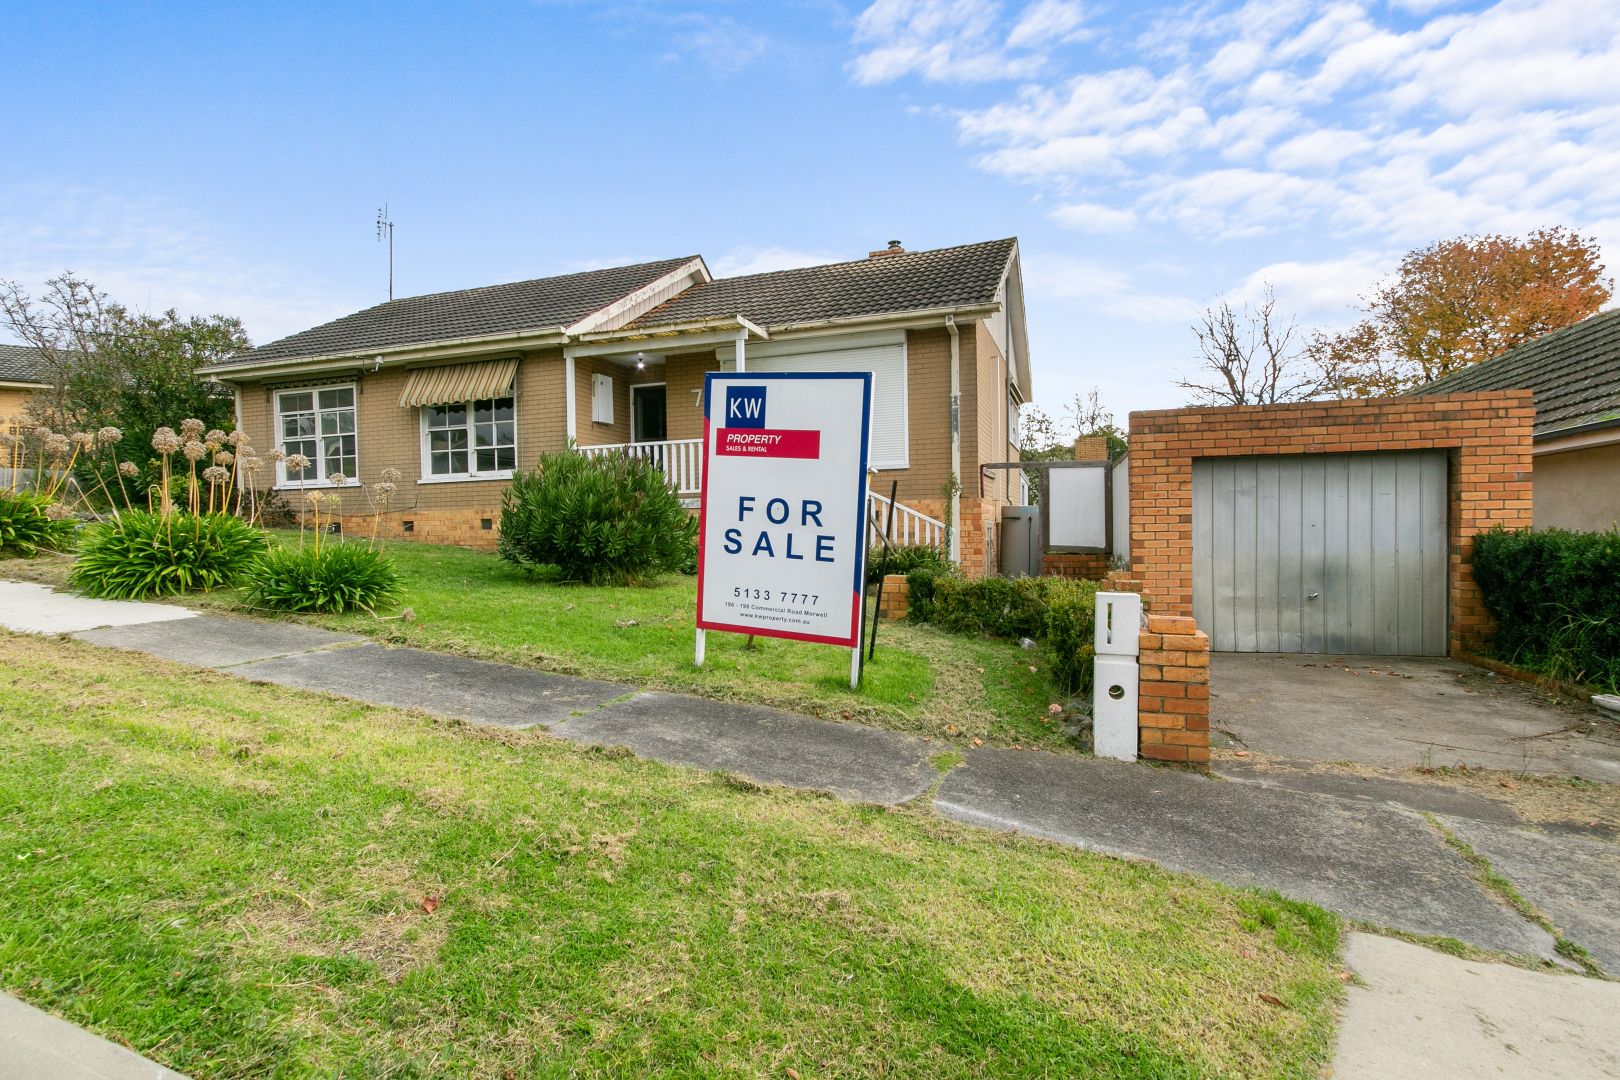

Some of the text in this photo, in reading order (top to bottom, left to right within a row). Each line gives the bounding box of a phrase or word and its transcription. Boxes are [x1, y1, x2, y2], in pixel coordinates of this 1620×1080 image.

[730, 398, 762, 419] KW
[727, 434, 782, 444] PROPERTY
[738, 496, 823, 527] FOR
[723, 528, 835, 562] SALE
[734, 587, 819, 606] 5133 7777
[740, 612, 810, 625] www.kwproperty.com.au
[751, 604, 786, 613] Commercial
[787, 608, 803, 616] Road
[804, 610, 828, 618] Morwell
